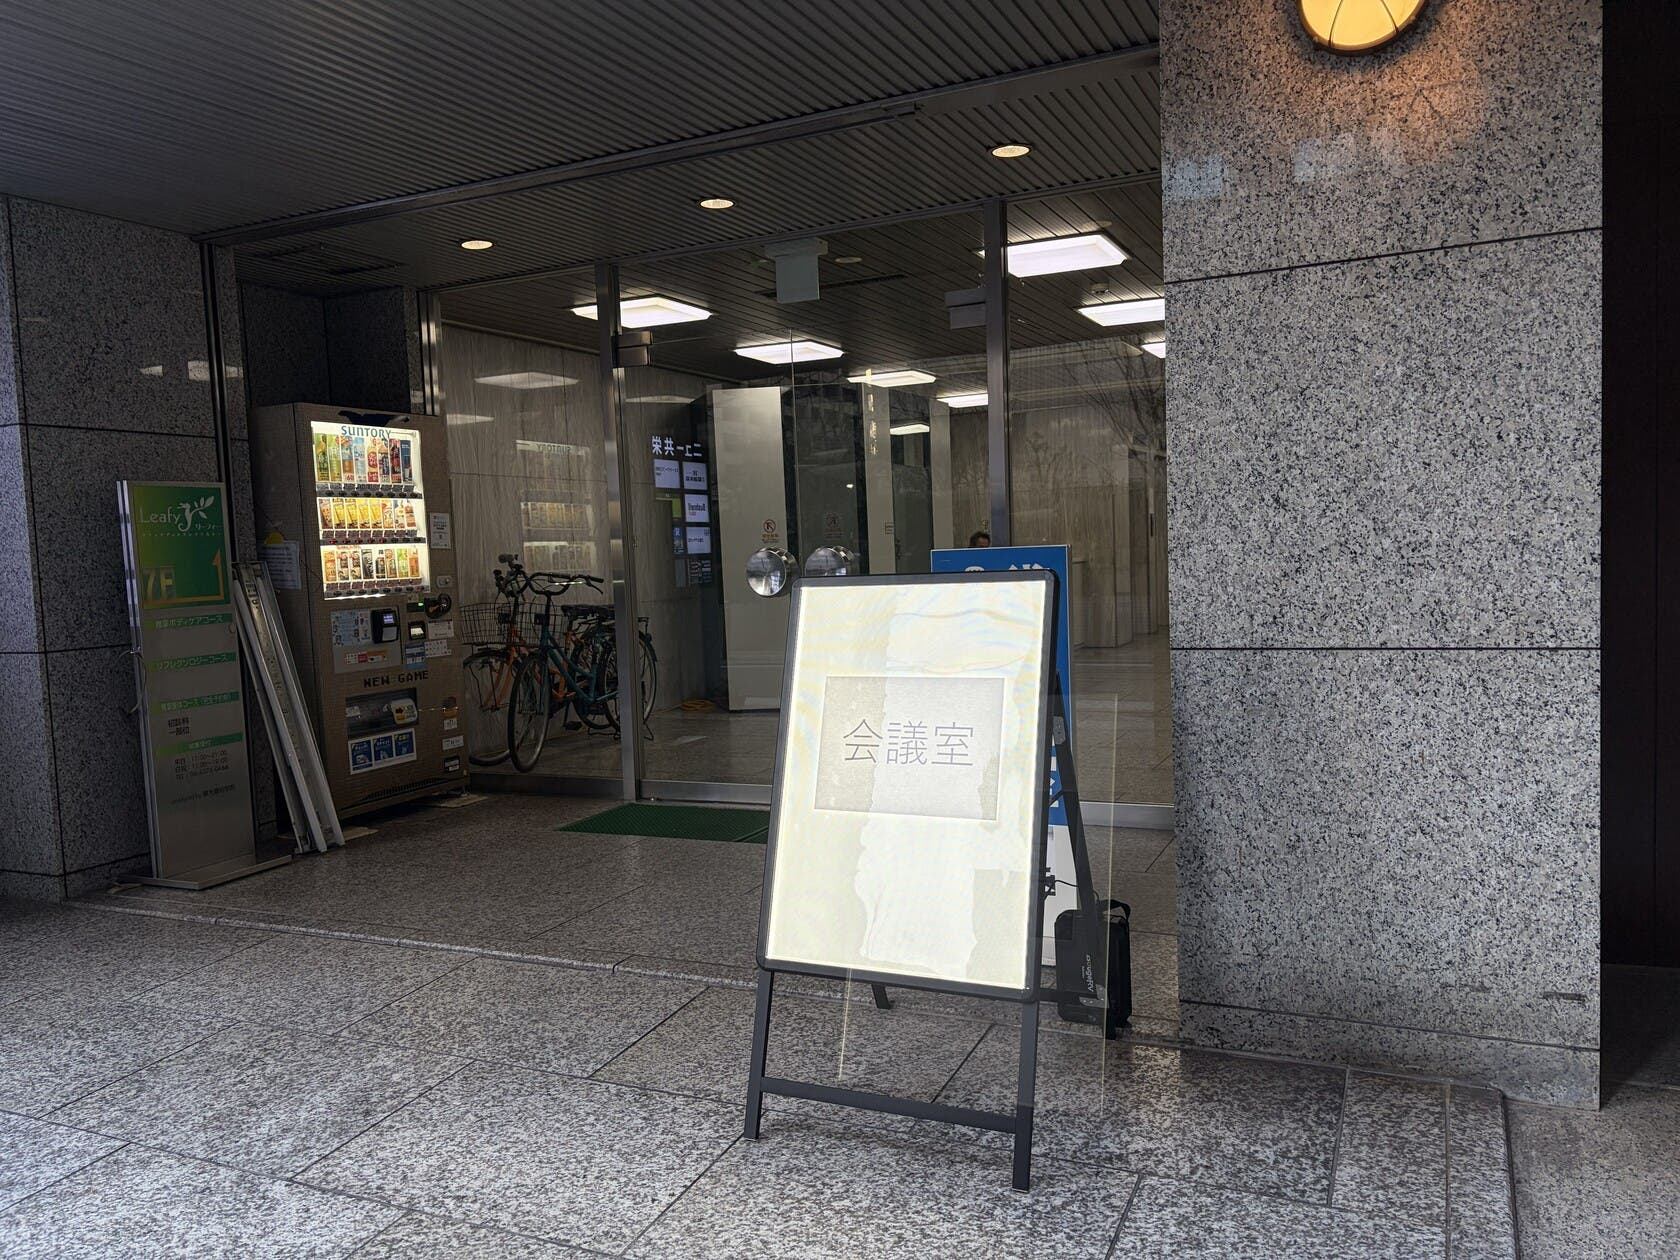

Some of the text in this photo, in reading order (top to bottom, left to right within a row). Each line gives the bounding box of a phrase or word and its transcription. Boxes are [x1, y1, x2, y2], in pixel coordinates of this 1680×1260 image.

[341, 425, 392, 441] SUNTORY
[139, 505, 181, 525] Leafy
[363, 670, 430, 689] NEW GAME
[842, 718, 975, 768] 会議室
